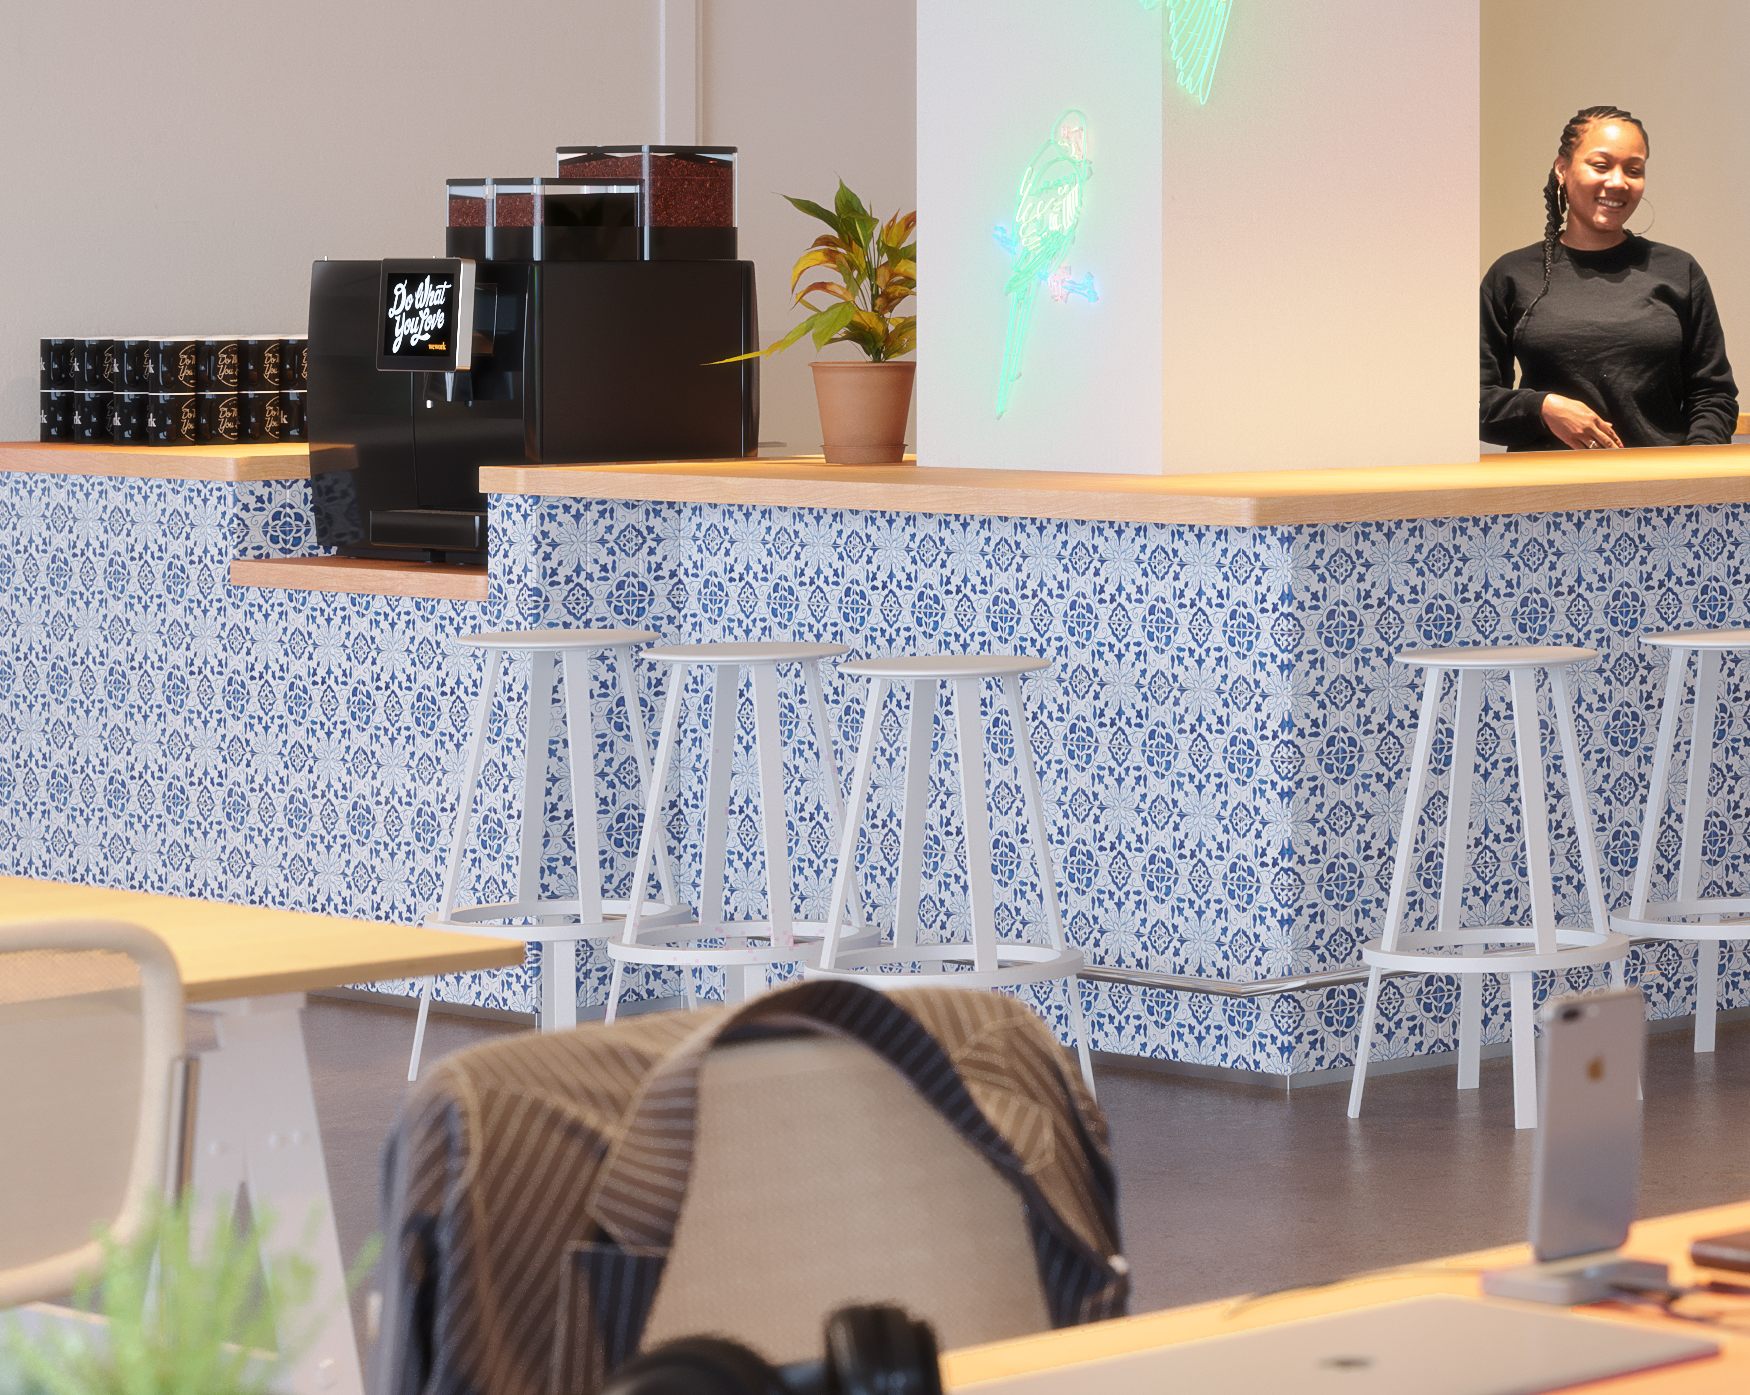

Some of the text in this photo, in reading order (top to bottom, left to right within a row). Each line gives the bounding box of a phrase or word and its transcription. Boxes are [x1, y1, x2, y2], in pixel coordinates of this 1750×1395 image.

[388, 275, 452, 318] Do What
[392, 308, 445, 353] You Love
